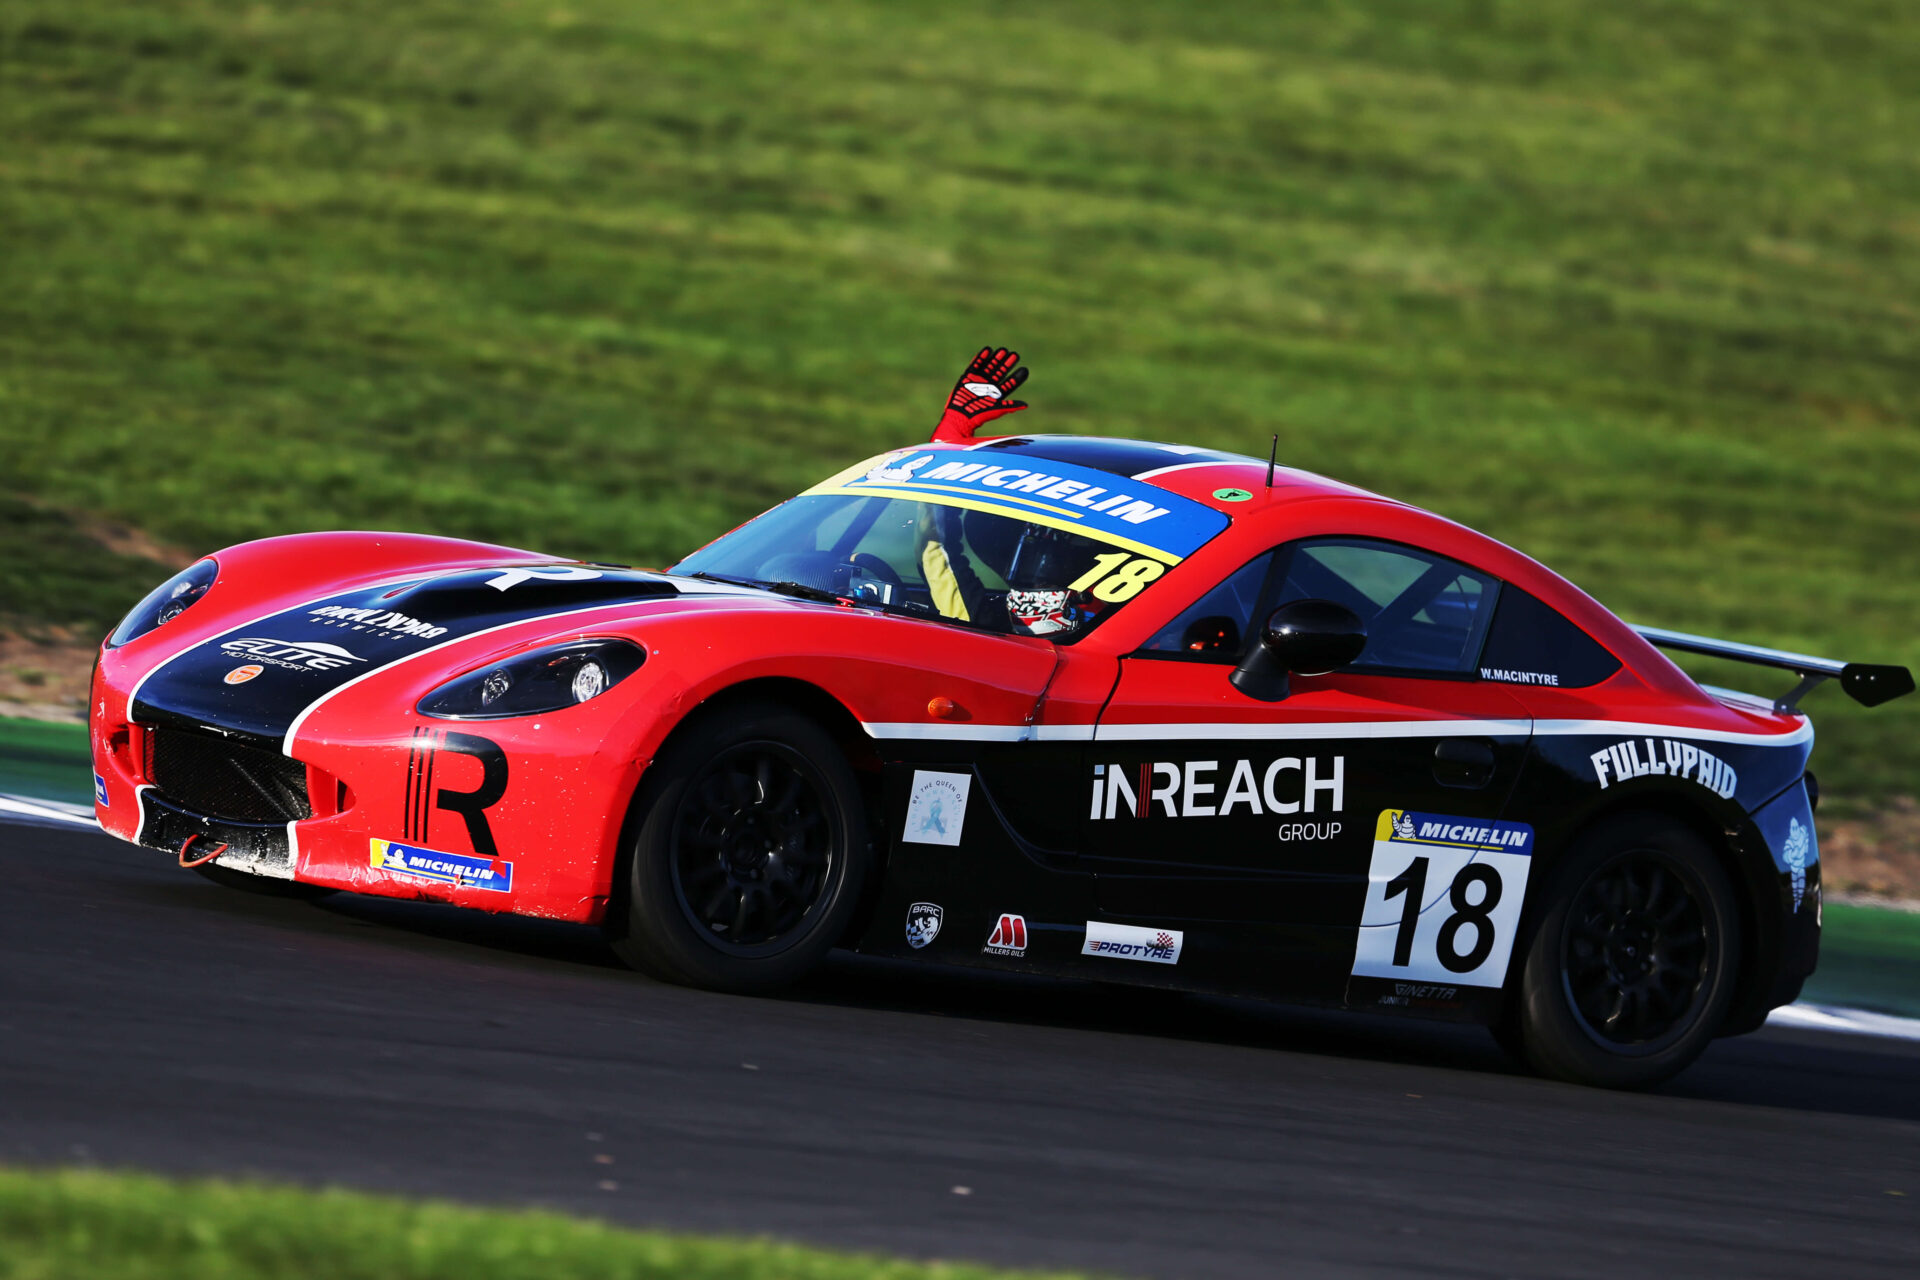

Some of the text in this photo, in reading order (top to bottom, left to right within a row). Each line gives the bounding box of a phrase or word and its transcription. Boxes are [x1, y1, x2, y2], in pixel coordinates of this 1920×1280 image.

[924, 461, 1171, 525] MICHELIN
[1068, 552, 1165, 603] 18
[220, 639, 352, 670] ELITE
[221, 650, 313, 672] MOTORSPORT
[1480, 667, 1559, 686] W.MACINTYRE
[1590, 738, 1738, 800] FULLYPAID
[935, 780, 957, 793] QUEEN
[1278, 822, 1342, 842] GROUP
[1419, 821, 1528, 847] MICHELIN
[409, 856, 496, 880] MICHELIN
[912, 905, 940, 917] BARC
[1383, 856, 1503, 975] 18
[983, 946, 1025, 958] MILLERS OILS
[1097, 941, 1175, 960] PROTYRE
[1395, 983, 1457, 1000] GINETTA
